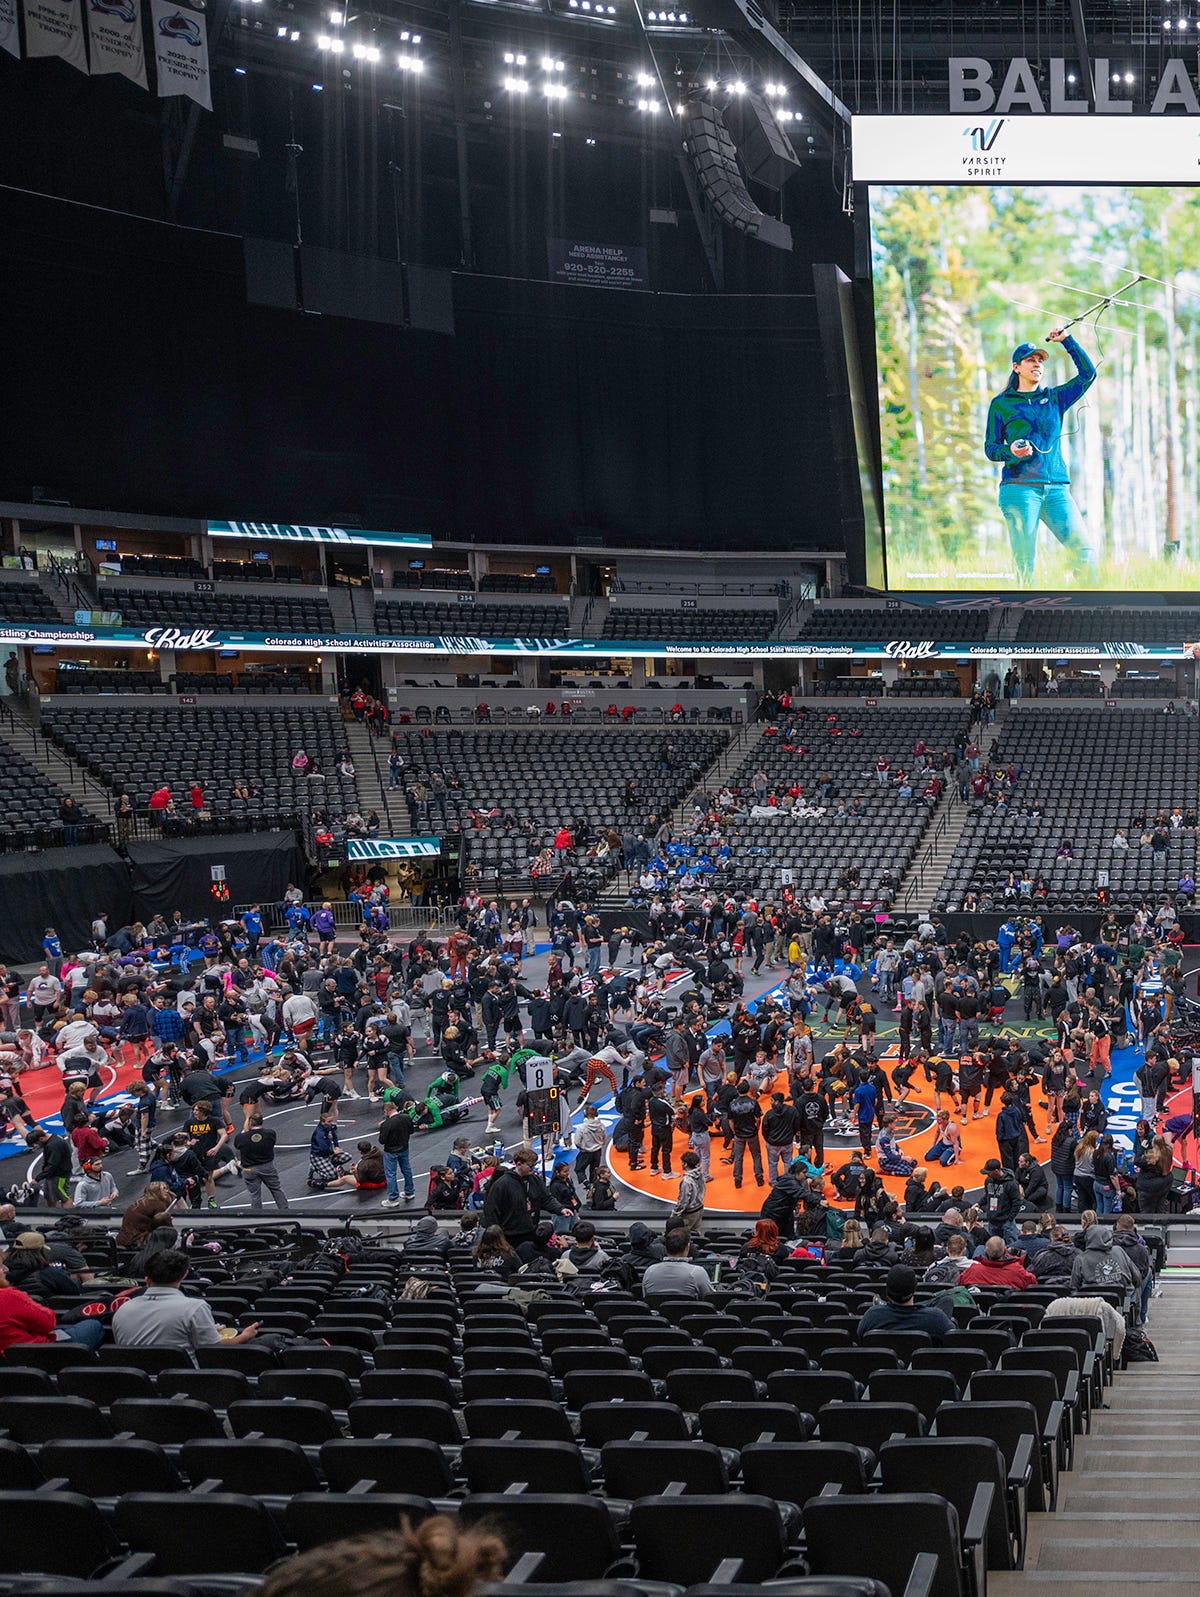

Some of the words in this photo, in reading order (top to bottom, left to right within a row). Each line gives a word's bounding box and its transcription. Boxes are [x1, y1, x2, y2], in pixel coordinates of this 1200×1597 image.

[39, 23, 72, 39] TROPHY
[101, 44, 134, 59] TROPHY
[167, 50, 198, 64] 2020-21
[168, 67, 200, 81] TROPHY
[948, 57, 1133, 113] BALL
[963, 157, 1006, 165] VARSITY
[968, 168, 1001, 176] SPIRIT
[568, 251, 586, 259] NEED
[573, 245, 602, 255] ARENA
[602, 248, 623, 256] HELP
[564, 262, 635, 277] 920-520-2255
[28, 629, 95, 641] Championships
[144, 627, 222, 649] Ball
[264, 638, 303, 646] Colorado
[304, 638, 324, 648] High
[325, 639, 352, 647] School
[353, 640, 390, 648] Activities
[391, 640, 435, 649] Association
[736, 646, 750, 655] High
[785, 646, 812, 655] Wrestling
[812, 646, 854, 655] Championships
[884, 640, 940, 659] Ball
[969, 646, 998, 654] Colorado
[998, 646, 1013, 655] High
[1014, 646, 1035, 654] School
[1035, 646, 1065, 655] Activities
[1065, 646, 1100, 655] Association
[535, 1069, 544, 1088] 8
[550, 1088, 557, 1099] 0
[190, 1124, 211, 1133] IOWA
[552, 1121, 560, 1132] 0
